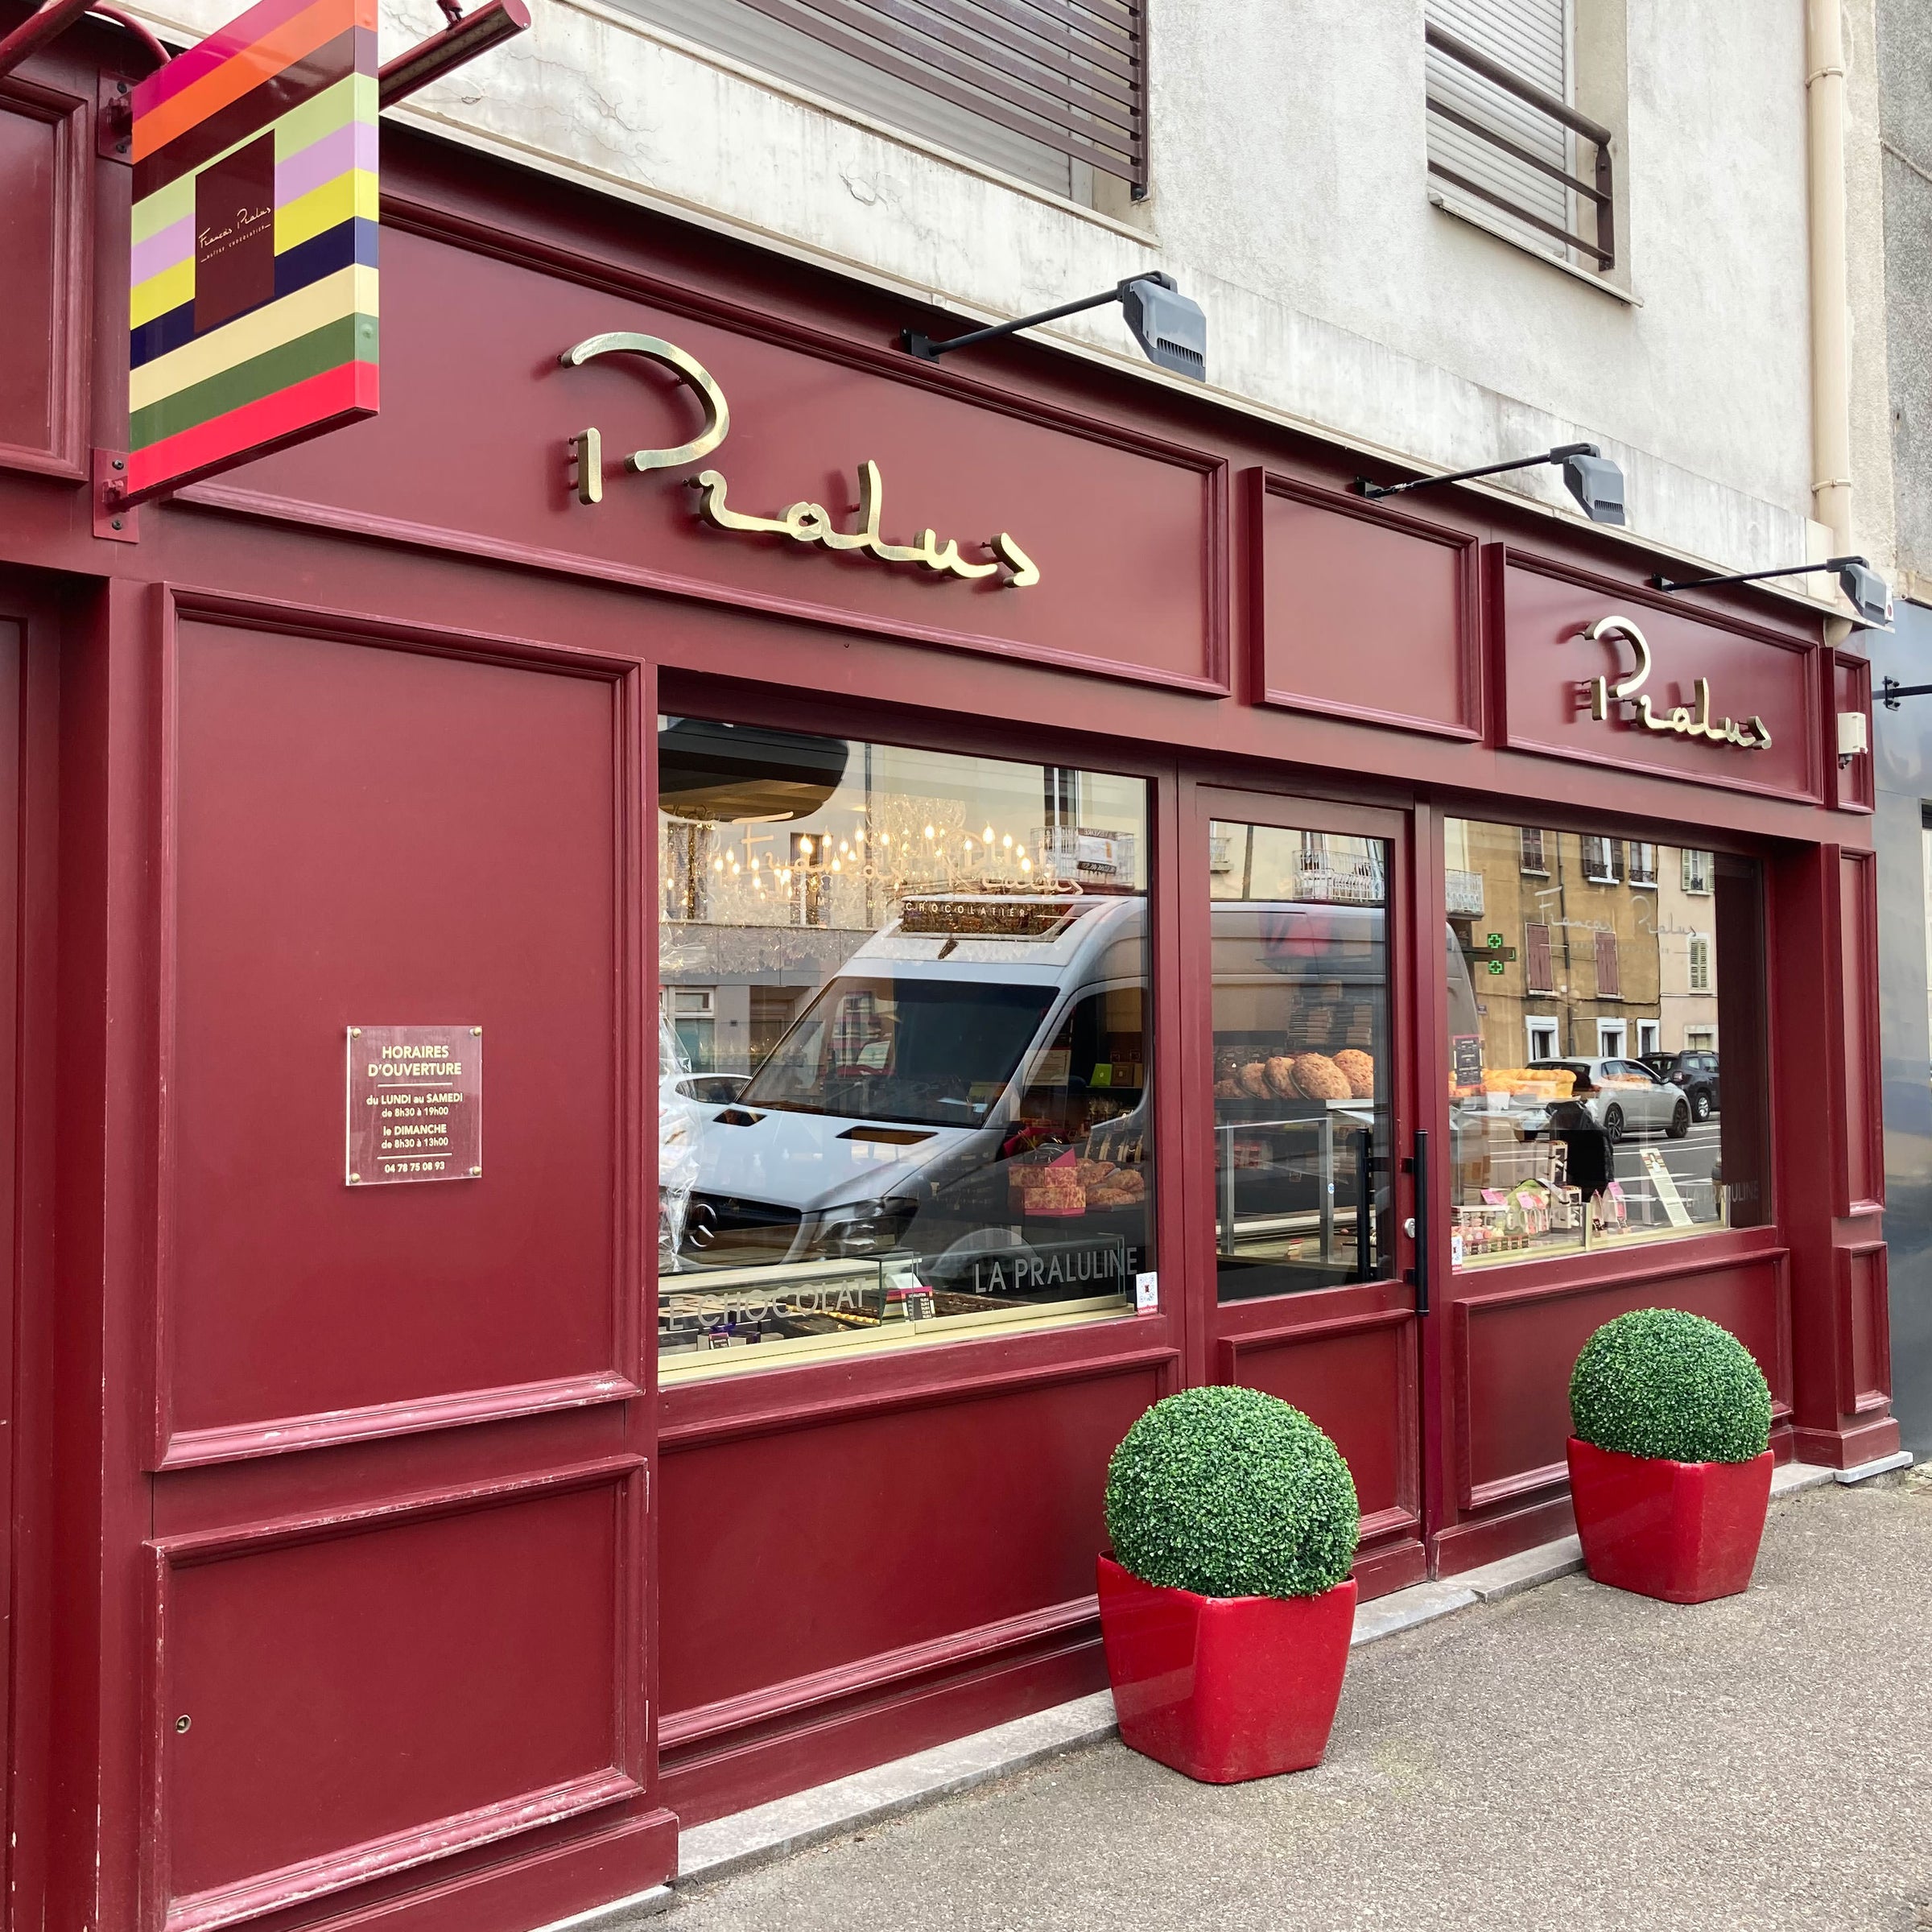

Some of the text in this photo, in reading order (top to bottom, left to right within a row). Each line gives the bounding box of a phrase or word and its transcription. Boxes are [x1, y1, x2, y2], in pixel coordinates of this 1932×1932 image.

[237, 207, 271, 230] Pralus
[562, 331, 1041, 588] Pralus
[1584, 615, 1772, 749] Pralus
[905, 902, 1026, 919] CHOCOLATIER
[382, 1045, 449, 1059] HORAIRES
[368, 1063, 462, 1076] D'OUVERTURE
[366, 1092, 463, 1105] du LUNDI au SAMEDI
[382, 1106, 448, 1117] de 8h30 à 19h00
[383, 1124, 447, 1136] le DIMANCHE
[382, 1137, 448, 1149] de 8h30 à 13h00
[385, 1161, 445, 1173] 04 78 75 08 93
[974, 1247, 1137, 1294] LA PRALULINE
[659, 1297, 683, 1331] E
[697, 1278, 866, 1327] CHOCOLAT
